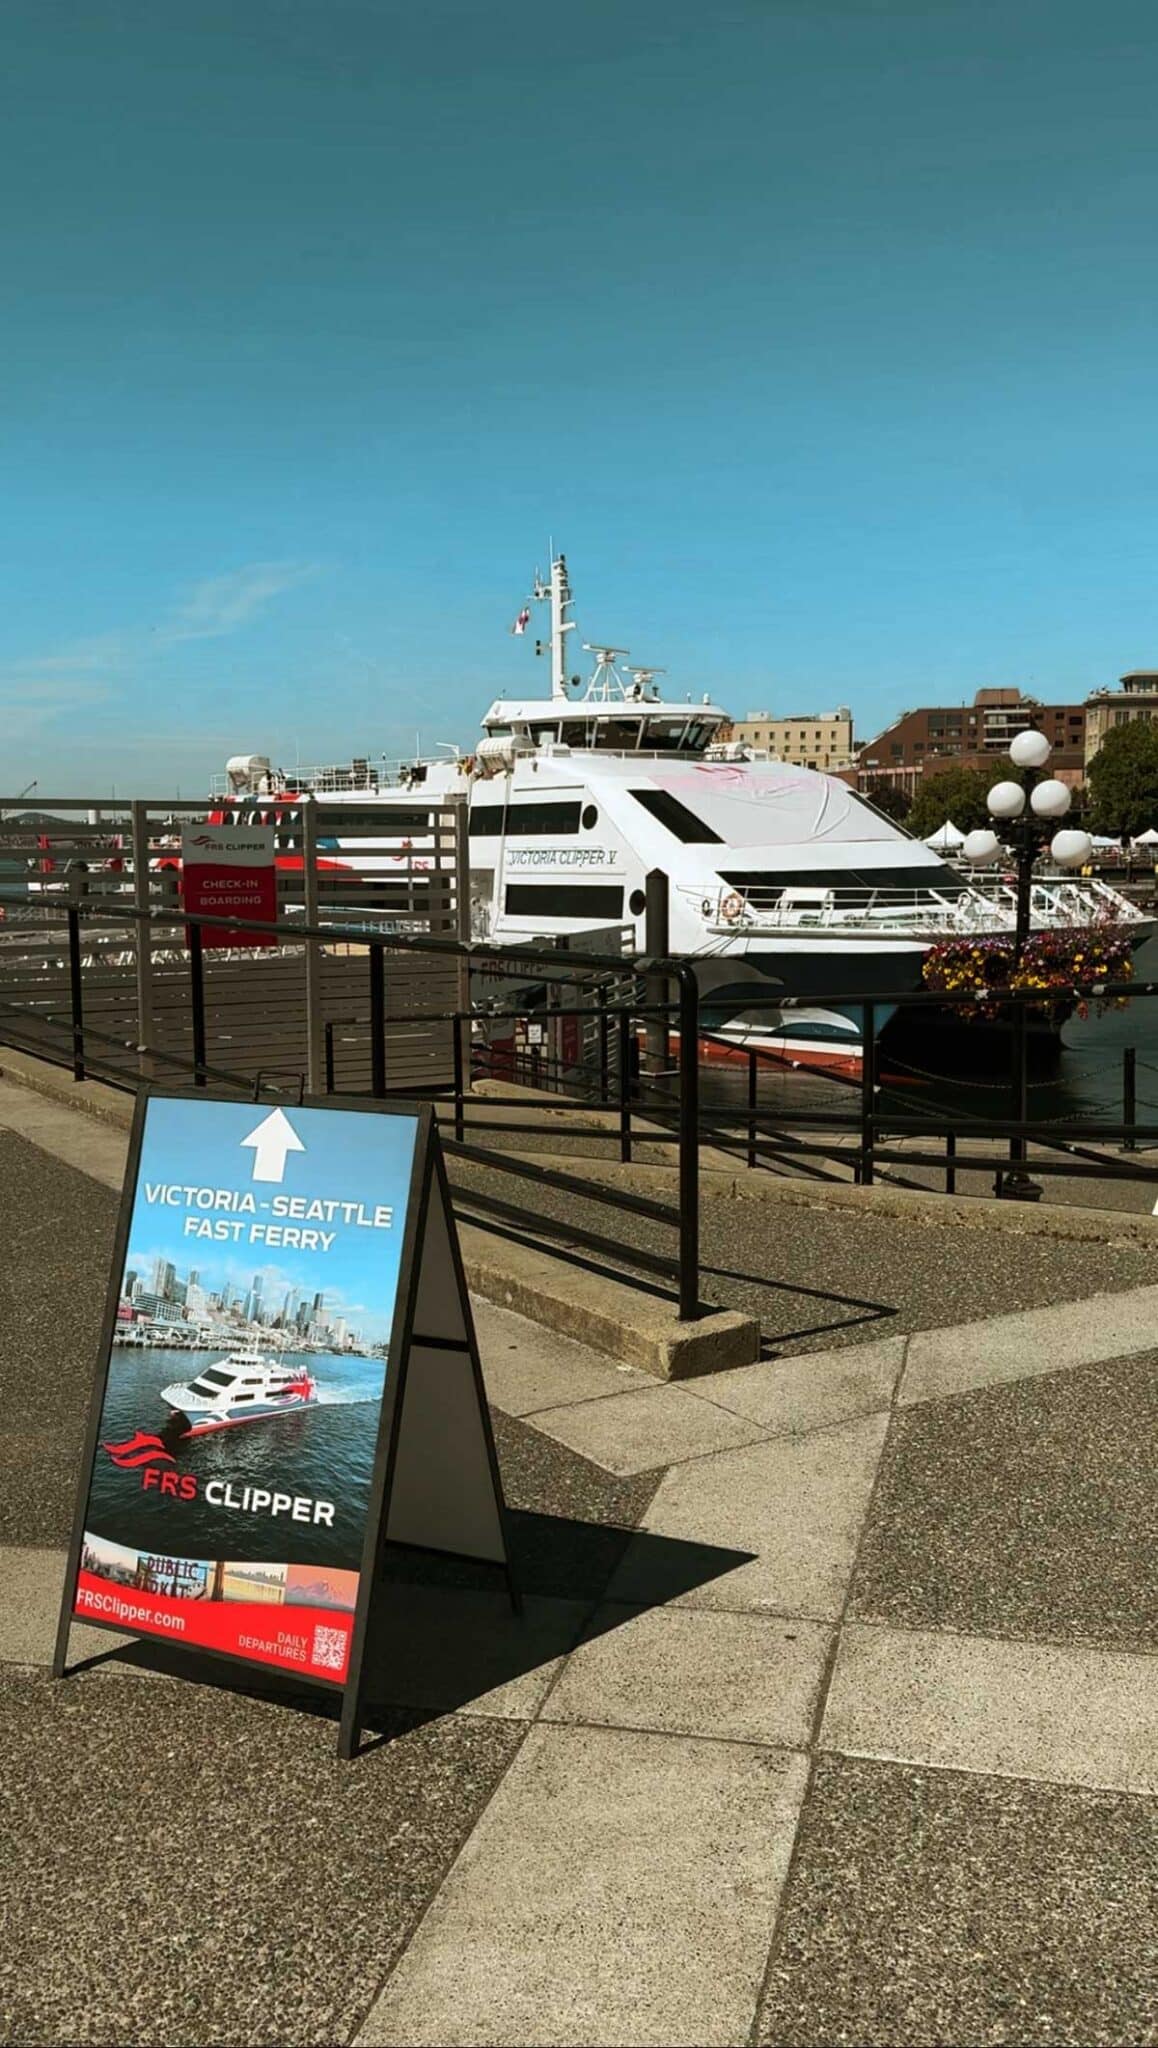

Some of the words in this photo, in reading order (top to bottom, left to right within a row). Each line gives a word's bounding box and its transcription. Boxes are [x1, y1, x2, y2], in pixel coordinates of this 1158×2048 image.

[205, 843, 223, 851] FRS
[225, 842, 265, 851] CLIPPER
[509, 849, 557, 865] VICTORIA
[559, 849, 605, 867] CLIPPER
[202, 879, 259, 889] CHECK-IN
[200, 895, 262, 906] BOARDING
[183, 1216, 245, 1242] FAST
[249, 1223, 336, 1252] FERRY
[142, 1468, 198, 1500] FRS
[205, 1481, 336, 1527] CLIPPER
[146, 1556, 199, 1580] PUBLIC
[76, 1588, 186, 1631] FRSClipper.com
[238, 1634, 307, 1662] DEPARTURES
[277, 1631, 309, 1649] DAILY
